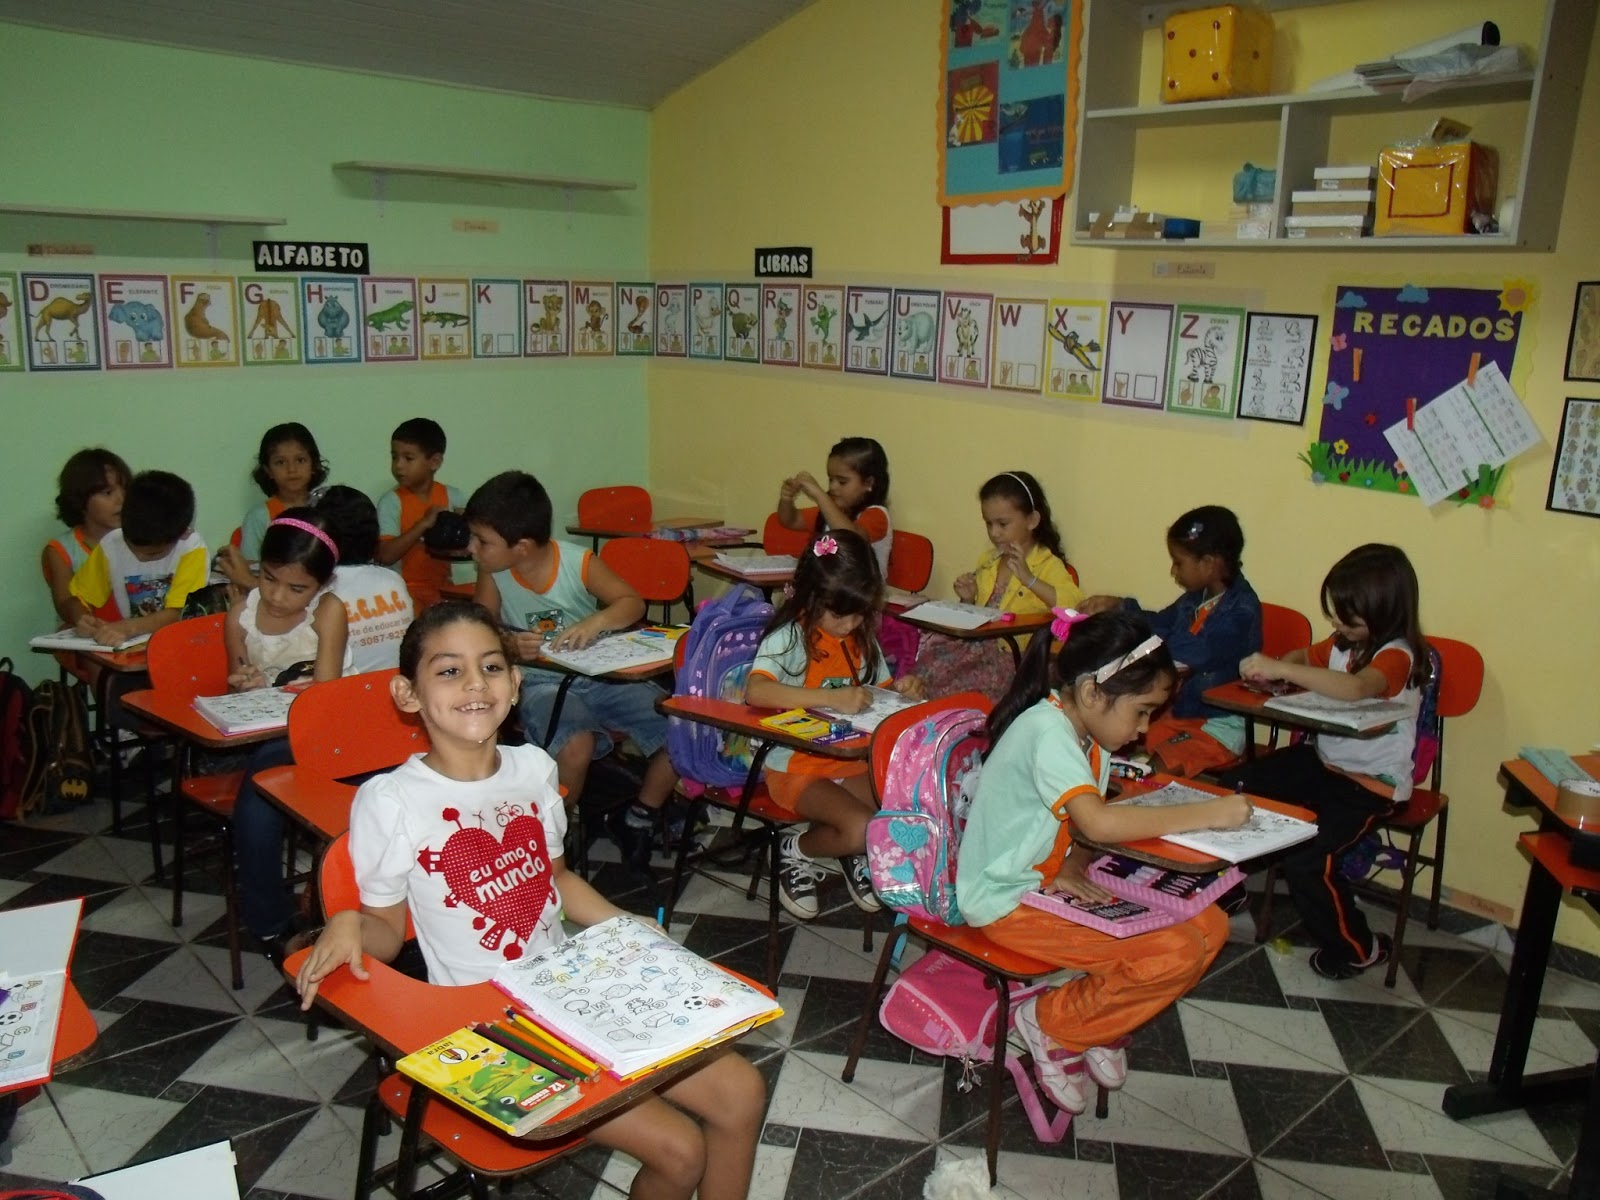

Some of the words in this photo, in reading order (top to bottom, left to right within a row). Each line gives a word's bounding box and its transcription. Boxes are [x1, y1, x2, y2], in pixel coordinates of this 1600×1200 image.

[258, 244, 363, 268] ALFABETO
[759, 254, 809, 274] LIBRAS
[29, 280, 49, 302] D
[106, 281, 125, 304] E
[180, 282, 195, 304] F
[244, 283, 264, 305] G
[306, 284, 323, 304] H
[372, 284, 377, 304] I
[424, 284, 437, 304] J
[477, 284, 492, 304] K
[529, 286, 541, 304] L
[575, 287, 590, 305] M
[620, 288, 633, 305] N
[659, 291, 669, 307] O
[693, 288, 703, 307] P
[728, 289, 740, 309] Q
[765, 290, 777, 309] R
[807, 291, 818, 311] S
[851, 293, 863, 314] T
[897, 296, 911, 317] U
[948, 299, 961, 320] V
[1000, 304, 1022, 327] W
[1055, 307, 1068, 331] X
[1116, 310, 1134, 335] Y
[1180, 314, 1200, 339] Z
[1353, 311, 1515, 342] RECADOS
[360, 629, 406, 647] 3087-925
[470, 864, 493, 883] eu
[495, 847, 526, 870] amo
[528, 839, 538, 852] o
[475, 852, 546, 904] mundo
[549, 1083, 566, 1093] 12
